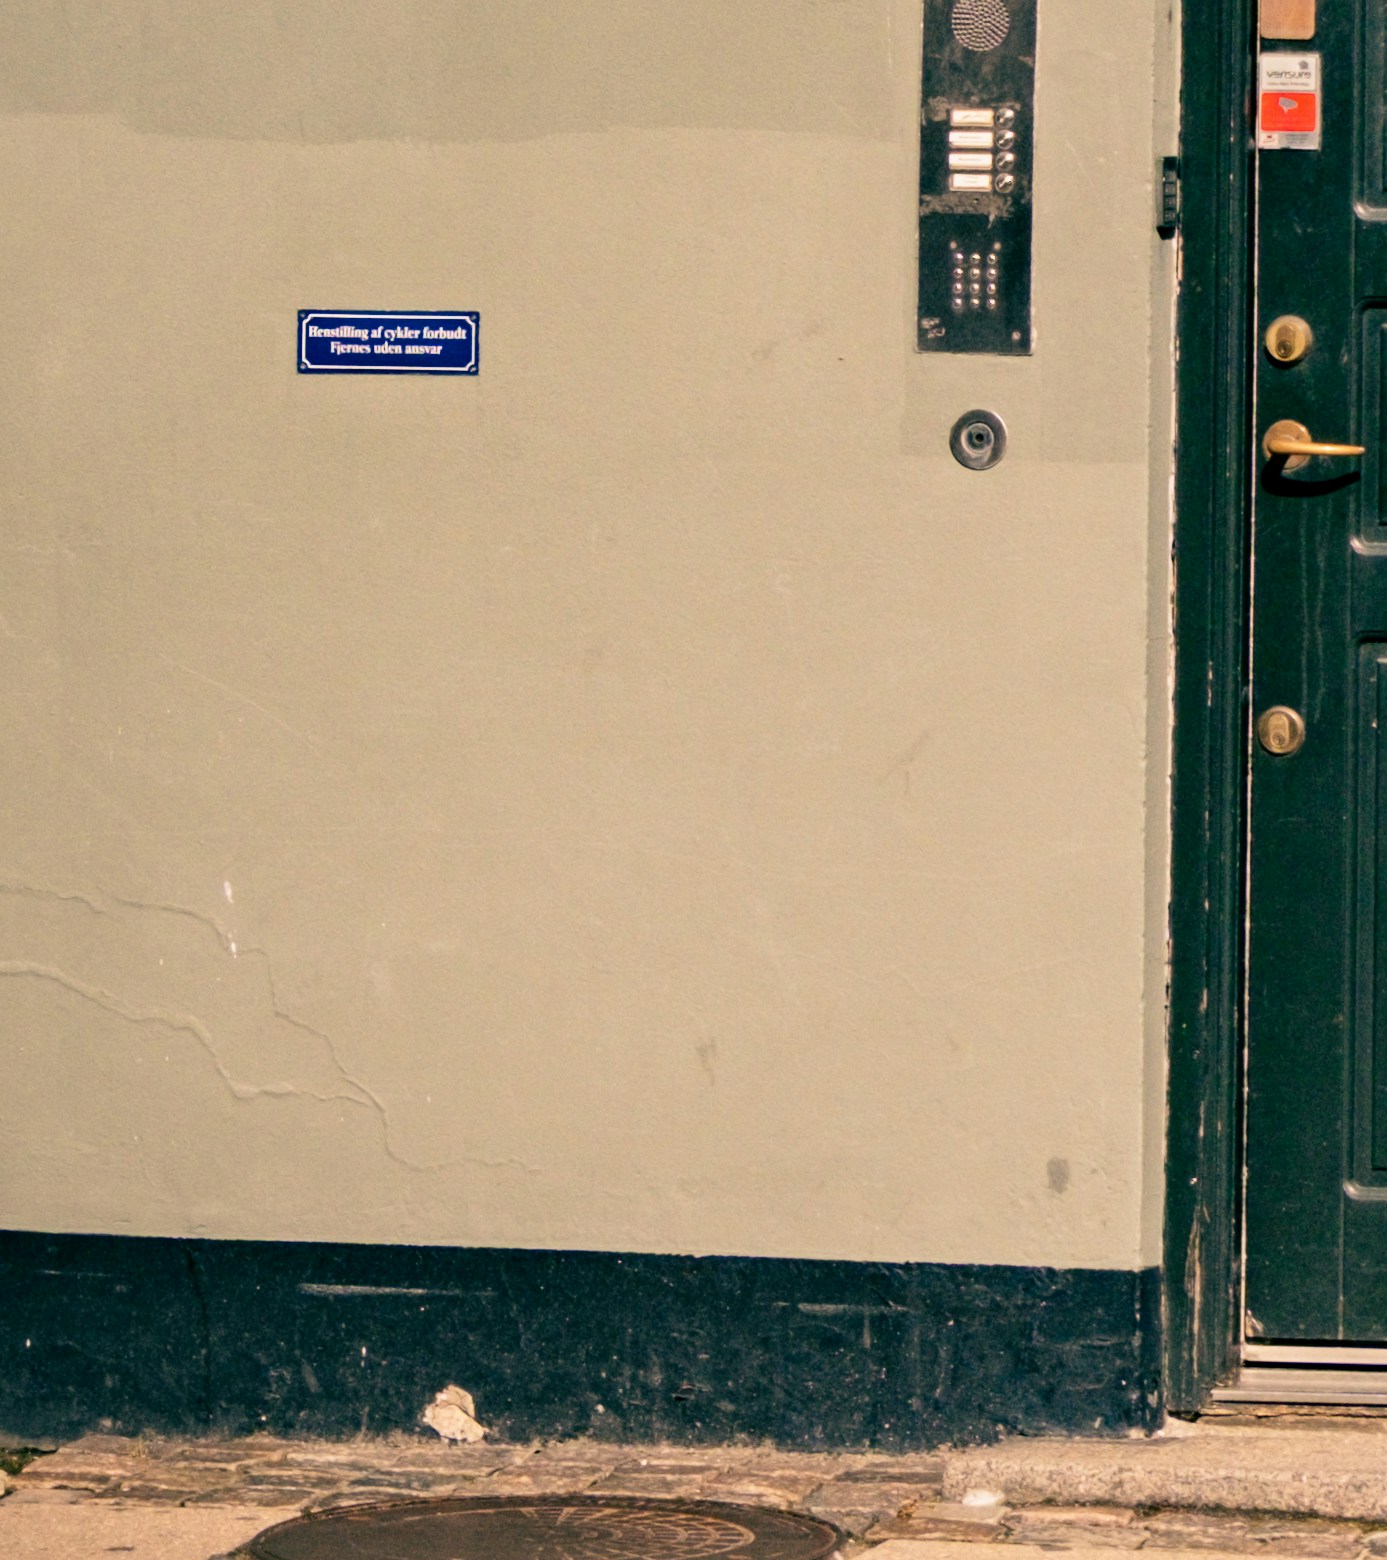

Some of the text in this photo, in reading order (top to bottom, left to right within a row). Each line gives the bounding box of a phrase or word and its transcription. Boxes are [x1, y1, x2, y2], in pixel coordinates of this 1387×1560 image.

[308, 325, 467, 341] Henstilling af cykler forbudt
[330, 341, 442, 355] Fjernes uden ansvar
